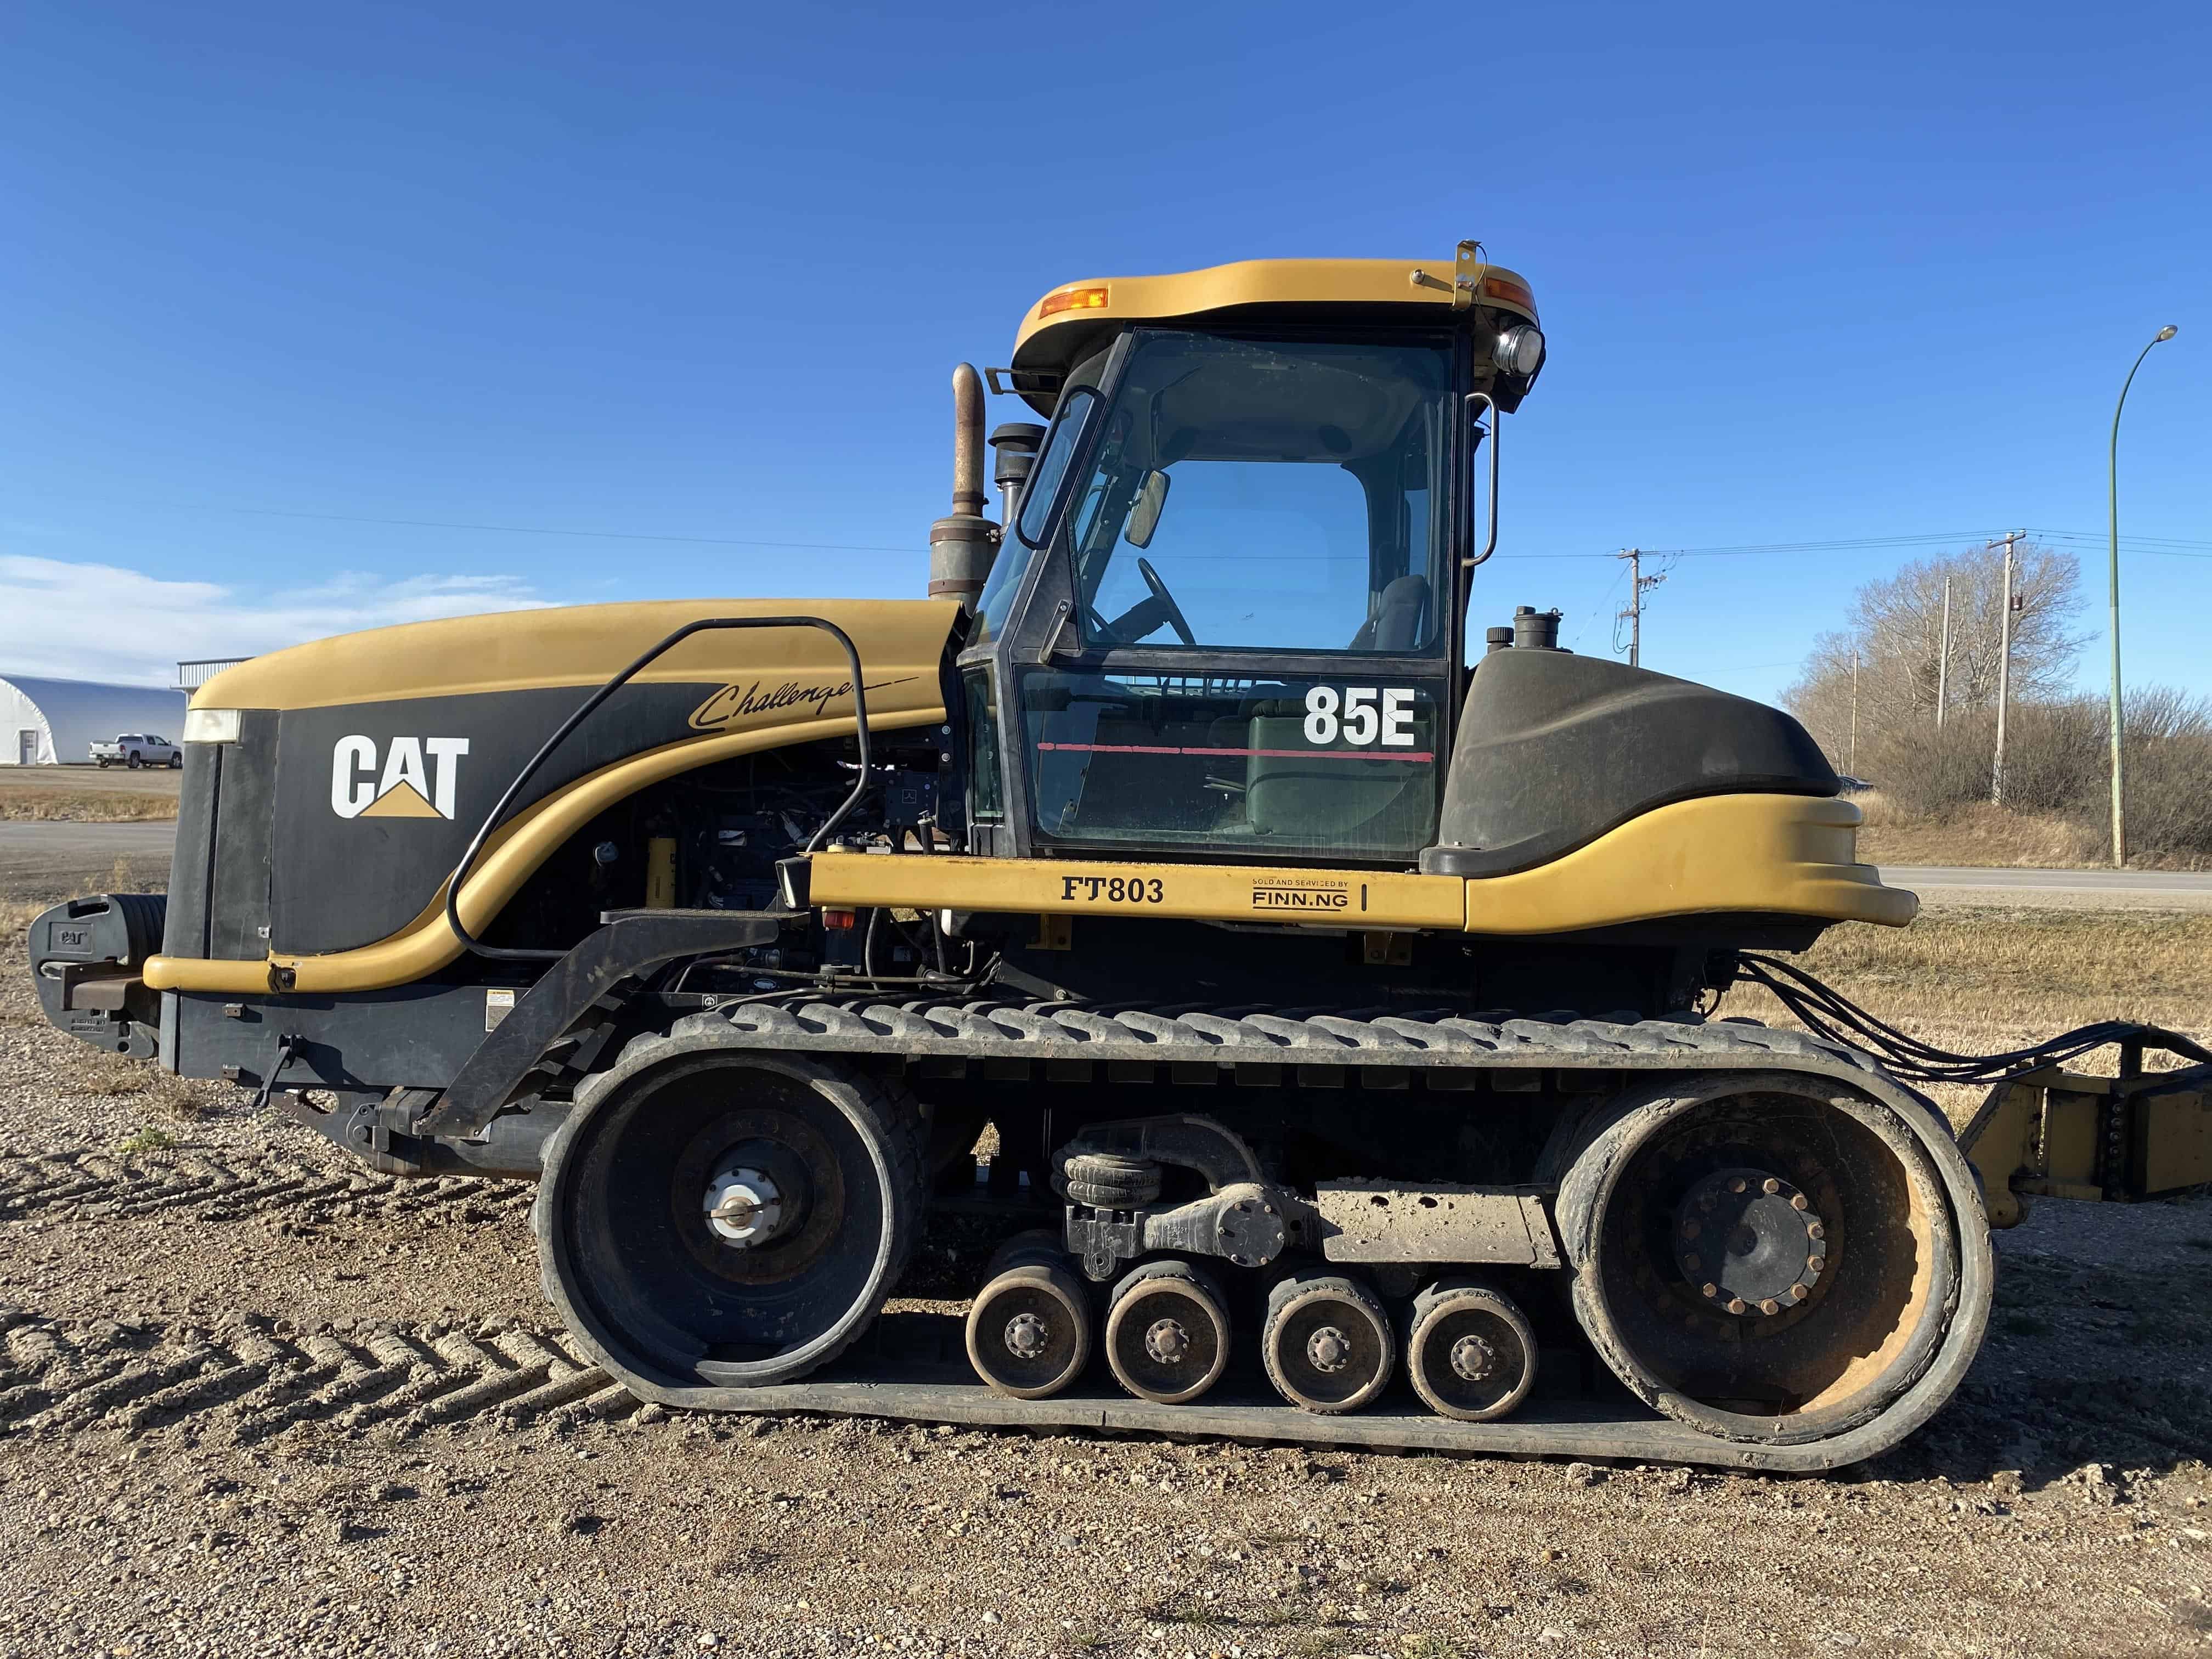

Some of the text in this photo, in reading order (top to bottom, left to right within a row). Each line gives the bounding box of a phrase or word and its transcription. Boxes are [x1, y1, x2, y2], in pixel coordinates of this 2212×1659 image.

[695, 680, 864, 726] Challenge
[1304, 686, 1415, 746] 85E
[331, 735, 470, 820] CAT
[1061, 876, 1164, 903] FT803
[1252, 892, 1348, 907] FINNNG
